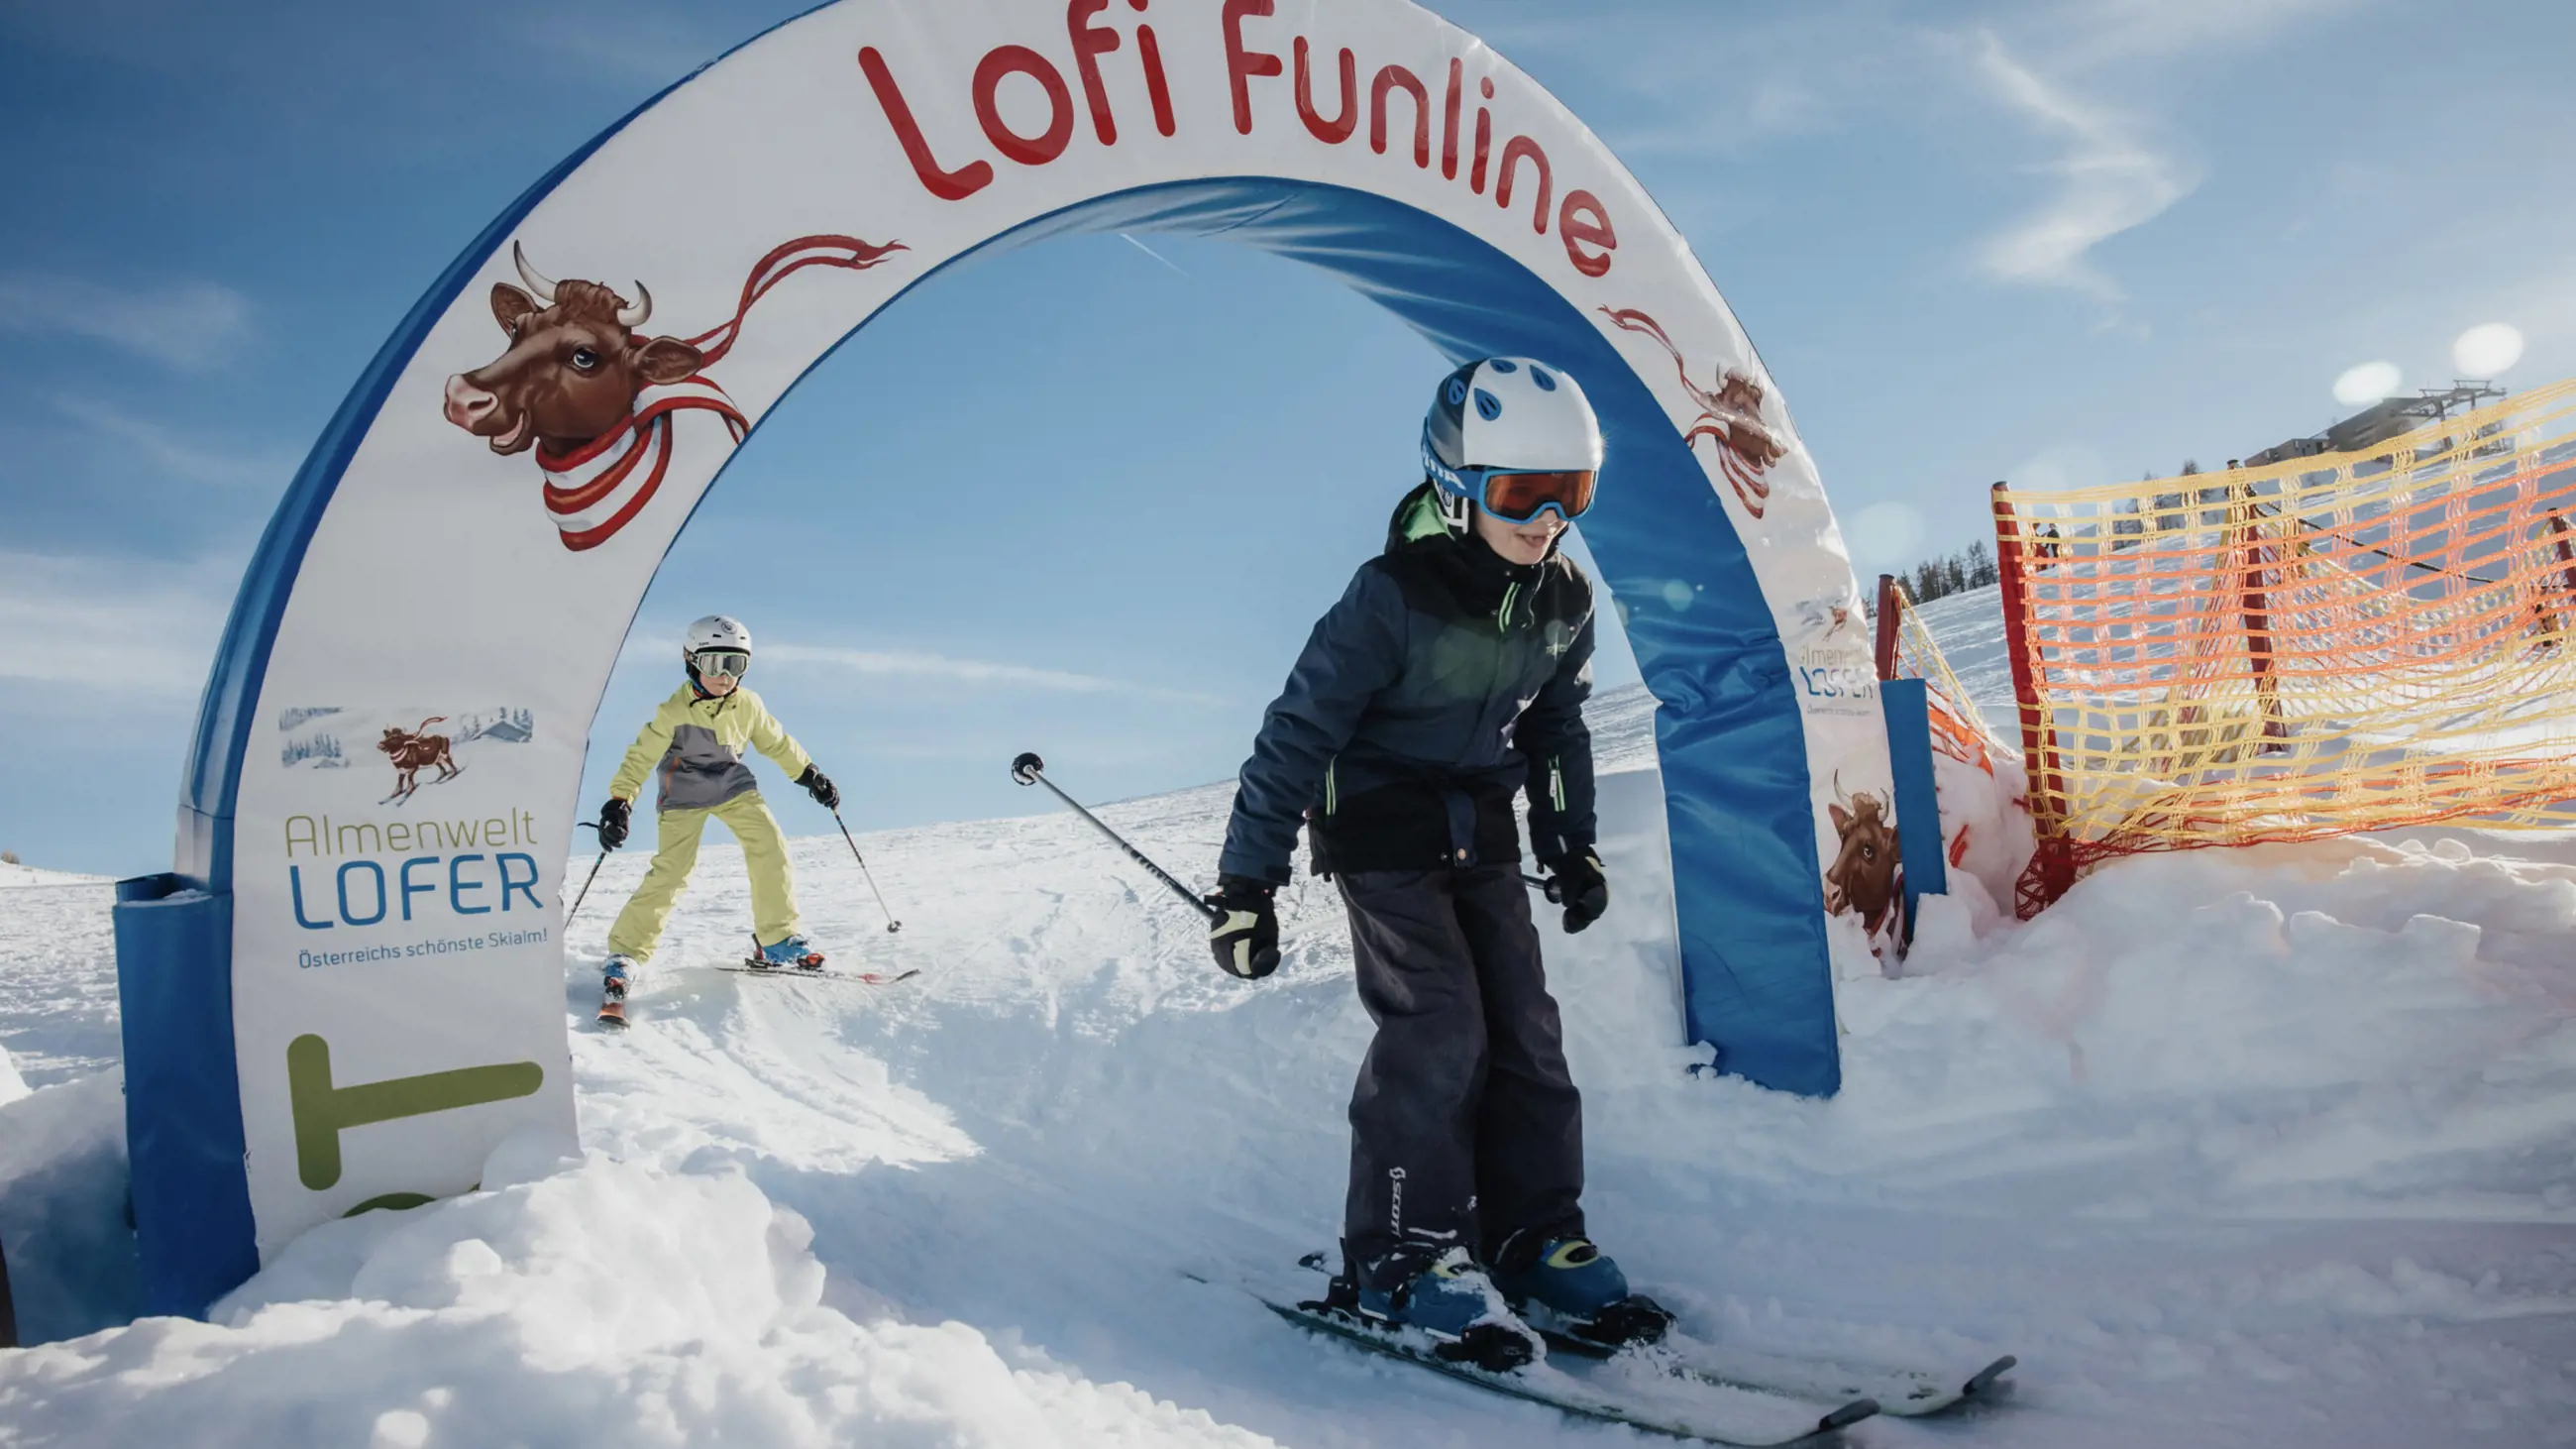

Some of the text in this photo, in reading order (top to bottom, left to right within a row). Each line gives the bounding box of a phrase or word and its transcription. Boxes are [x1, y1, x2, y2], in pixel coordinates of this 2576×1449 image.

[858, 0, 1617, 278] Lofi Funline
[285, 807, 538, 857] Almenwelt
[289, 852, 544, 930] LOFER
[298, 928, 548, 968] Österreichs schönste Skialm!
